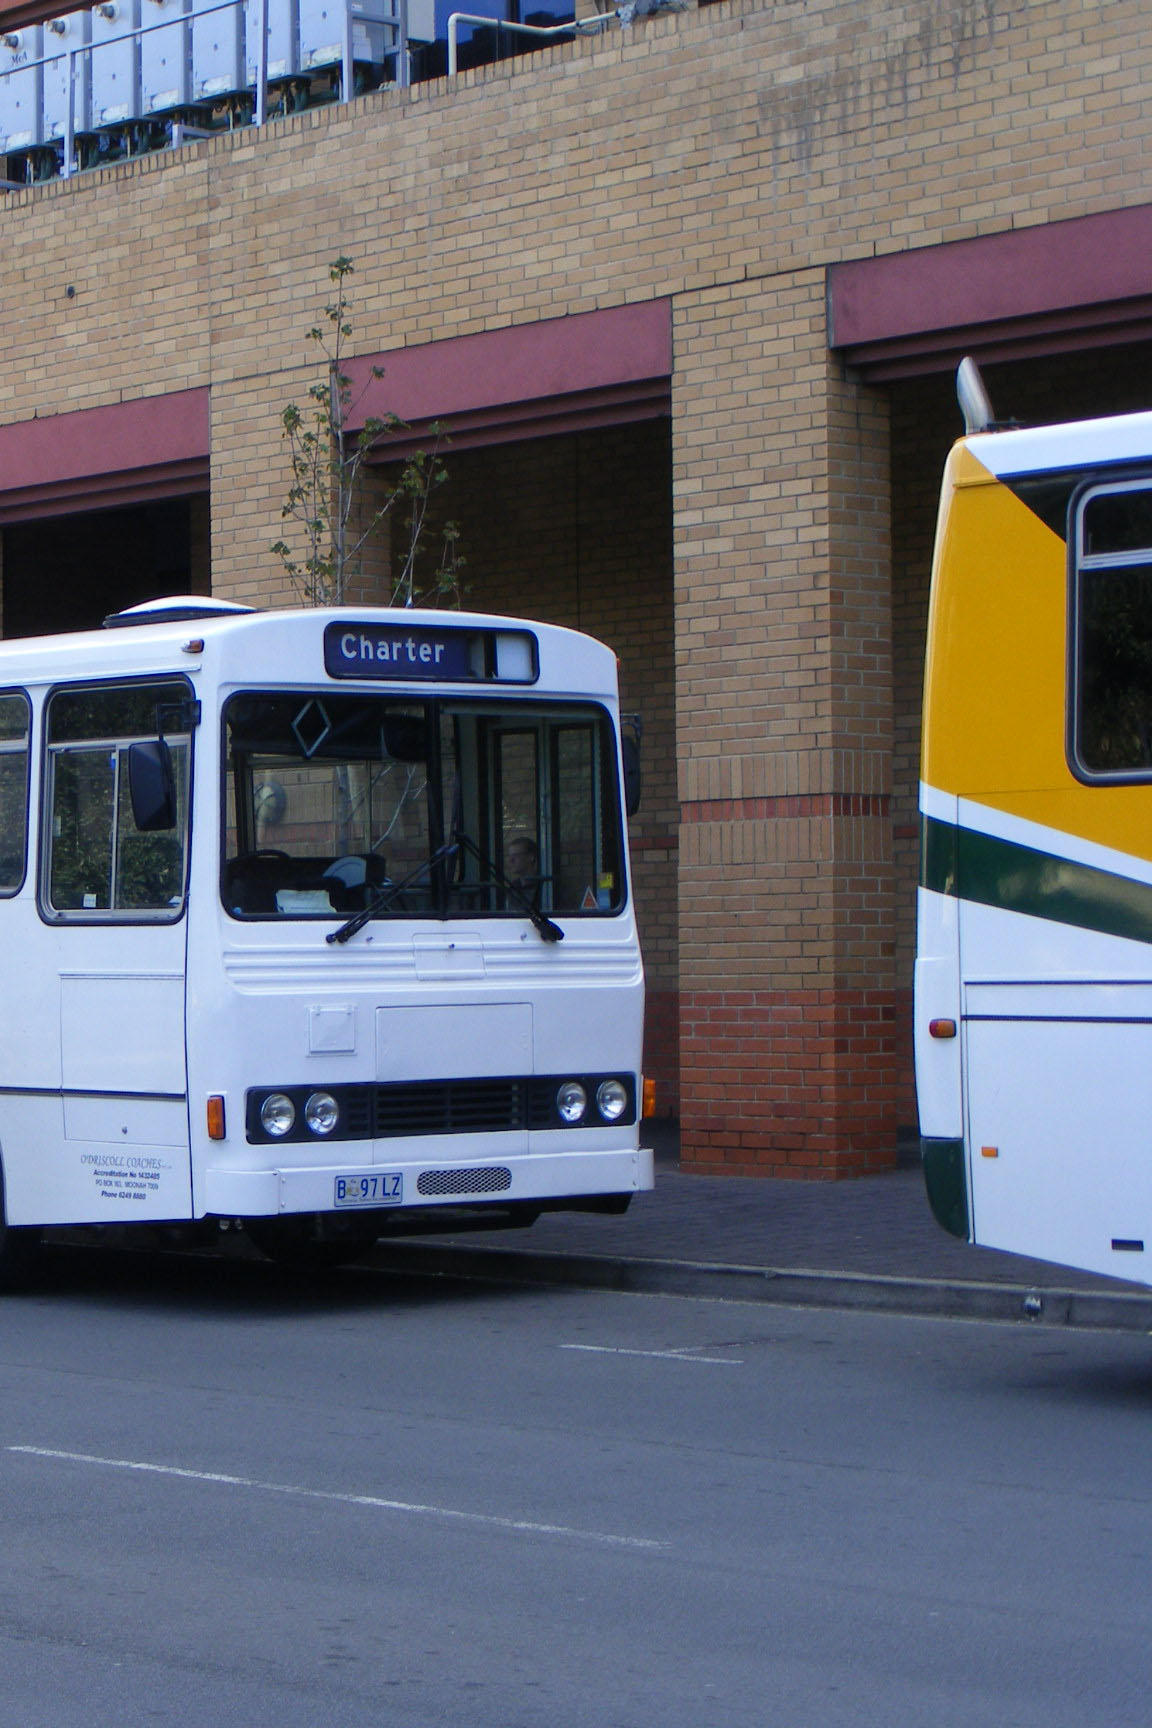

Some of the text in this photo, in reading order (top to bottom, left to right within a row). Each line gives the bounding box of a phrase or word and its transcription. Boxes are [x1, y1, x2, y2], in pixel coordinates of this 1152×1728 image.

[341, 633, 445, 663] Charter
[126, 1157, 161, 1169] COACHES
[94, 1169, 128, 1178] Accreditation
[101, 1190, 117, 1198] Phone
